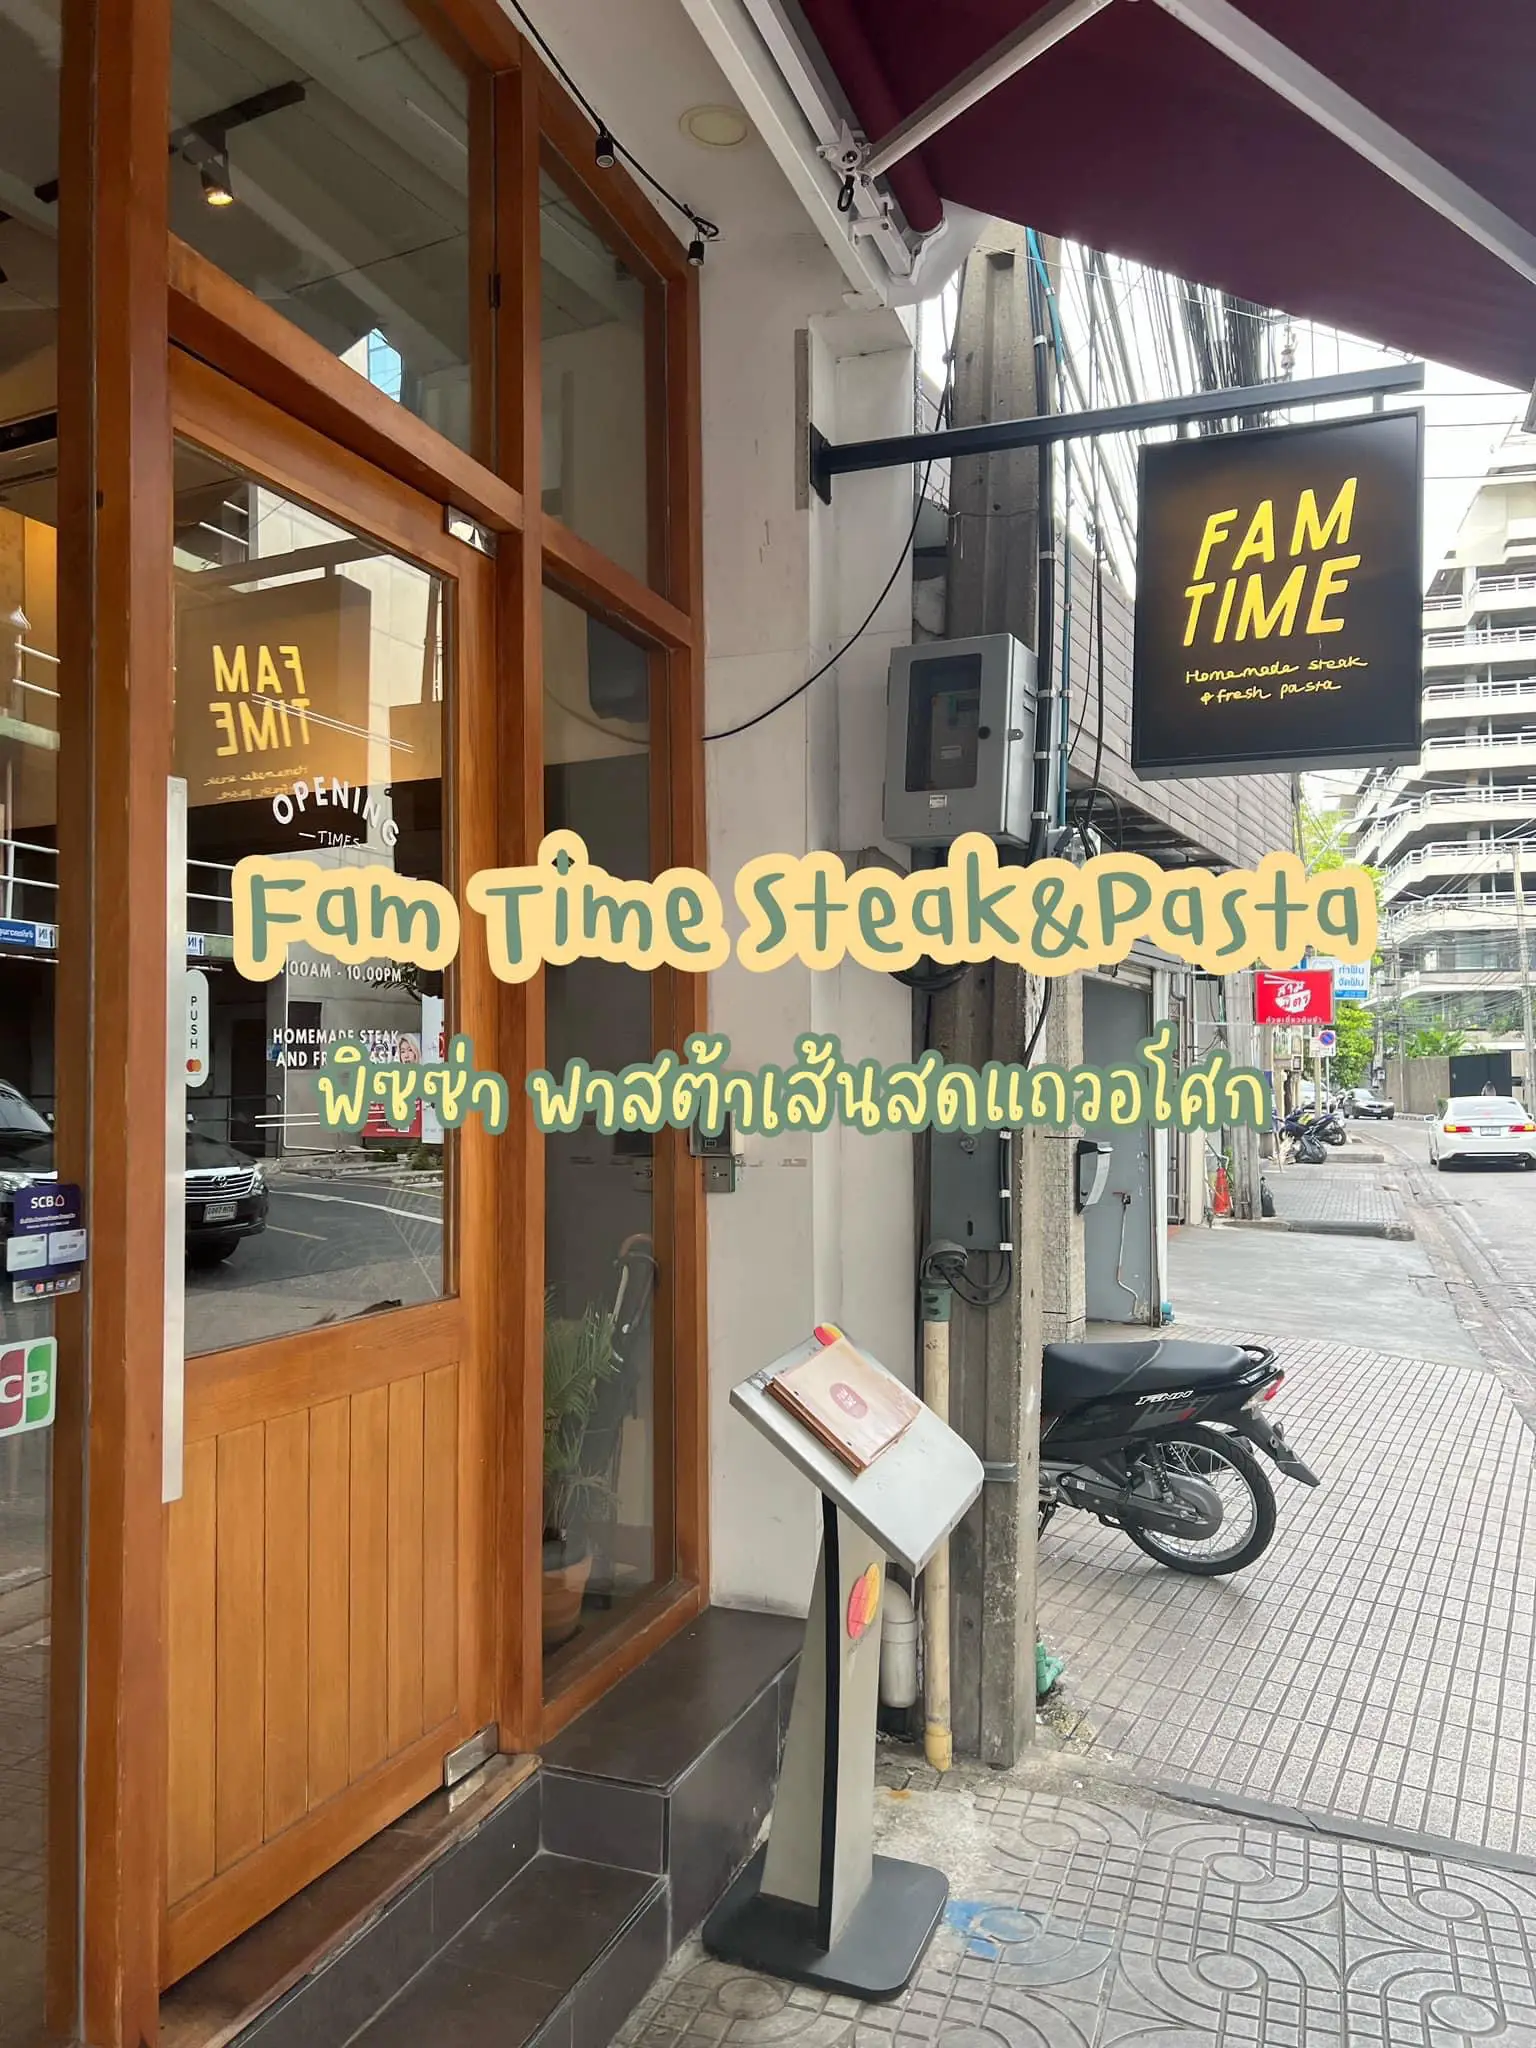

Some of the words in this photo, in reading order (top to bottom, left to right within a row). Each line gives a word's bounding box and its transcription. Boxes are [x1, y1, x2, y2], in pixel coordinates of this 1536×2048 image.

[1192, 477, 1358, 581] FAM
[1183, 554, 1361, 647] TIME
[1185, 661, 1300, 684] Homemade
[1307, 656, 1369, 671] steak
[1280, 679, 1342, 699] pasta
[272, 776, 400, 847] OPENING
[347, 966, 402, 982] 10.00PM
[190, 995, 198, 1049] PUSH
[273, 1028, 354, 1044] HOMEMADE
[360, 1030, 399, 1045] STEAK
[275, 1051, 307, 1067] AND
[369, 1051, 400, 1064] ASTA
[30, 1195, 54, 1209] SCB
[0, 1369, 48, 1404] CB
